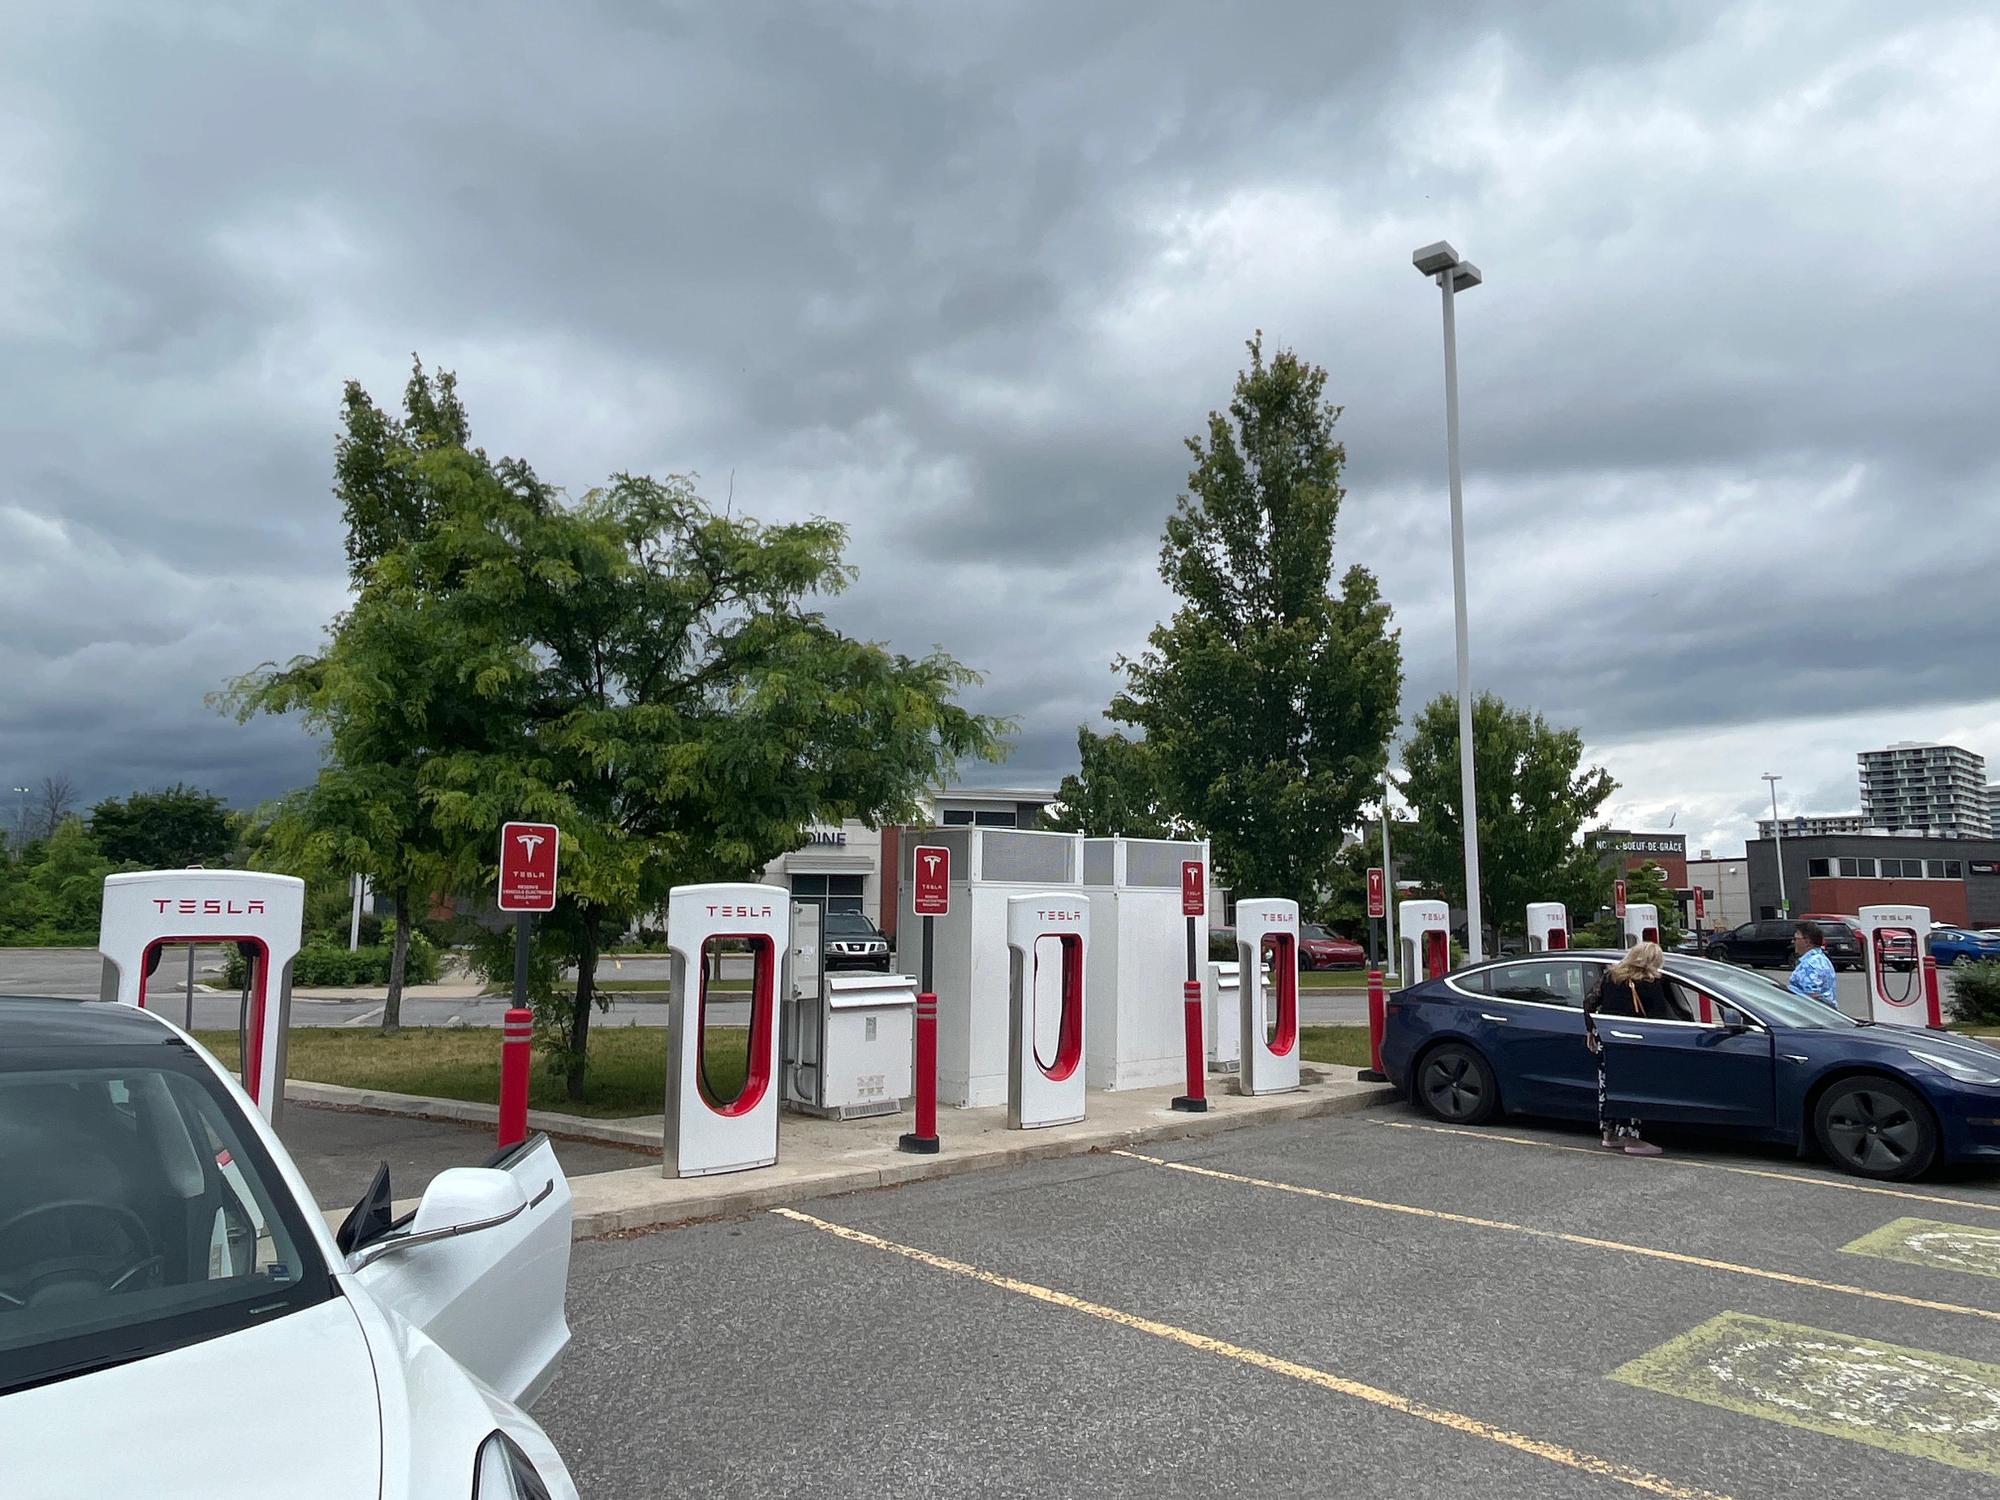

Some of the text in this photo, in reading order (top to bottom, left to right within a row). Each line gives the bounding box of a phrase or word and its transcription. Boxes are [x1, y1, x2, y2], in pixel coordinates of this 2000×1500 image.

[512, 870, 545, 878] TESLA
[153, 899, 265, 914] TESLA
[705, 906, 771, 918] TESLA
[1037, 911, 1081, 921] TESLA
[1261, 913, 1294, 922] TESLA
[1872, 914, 1913, 922] TESLA
